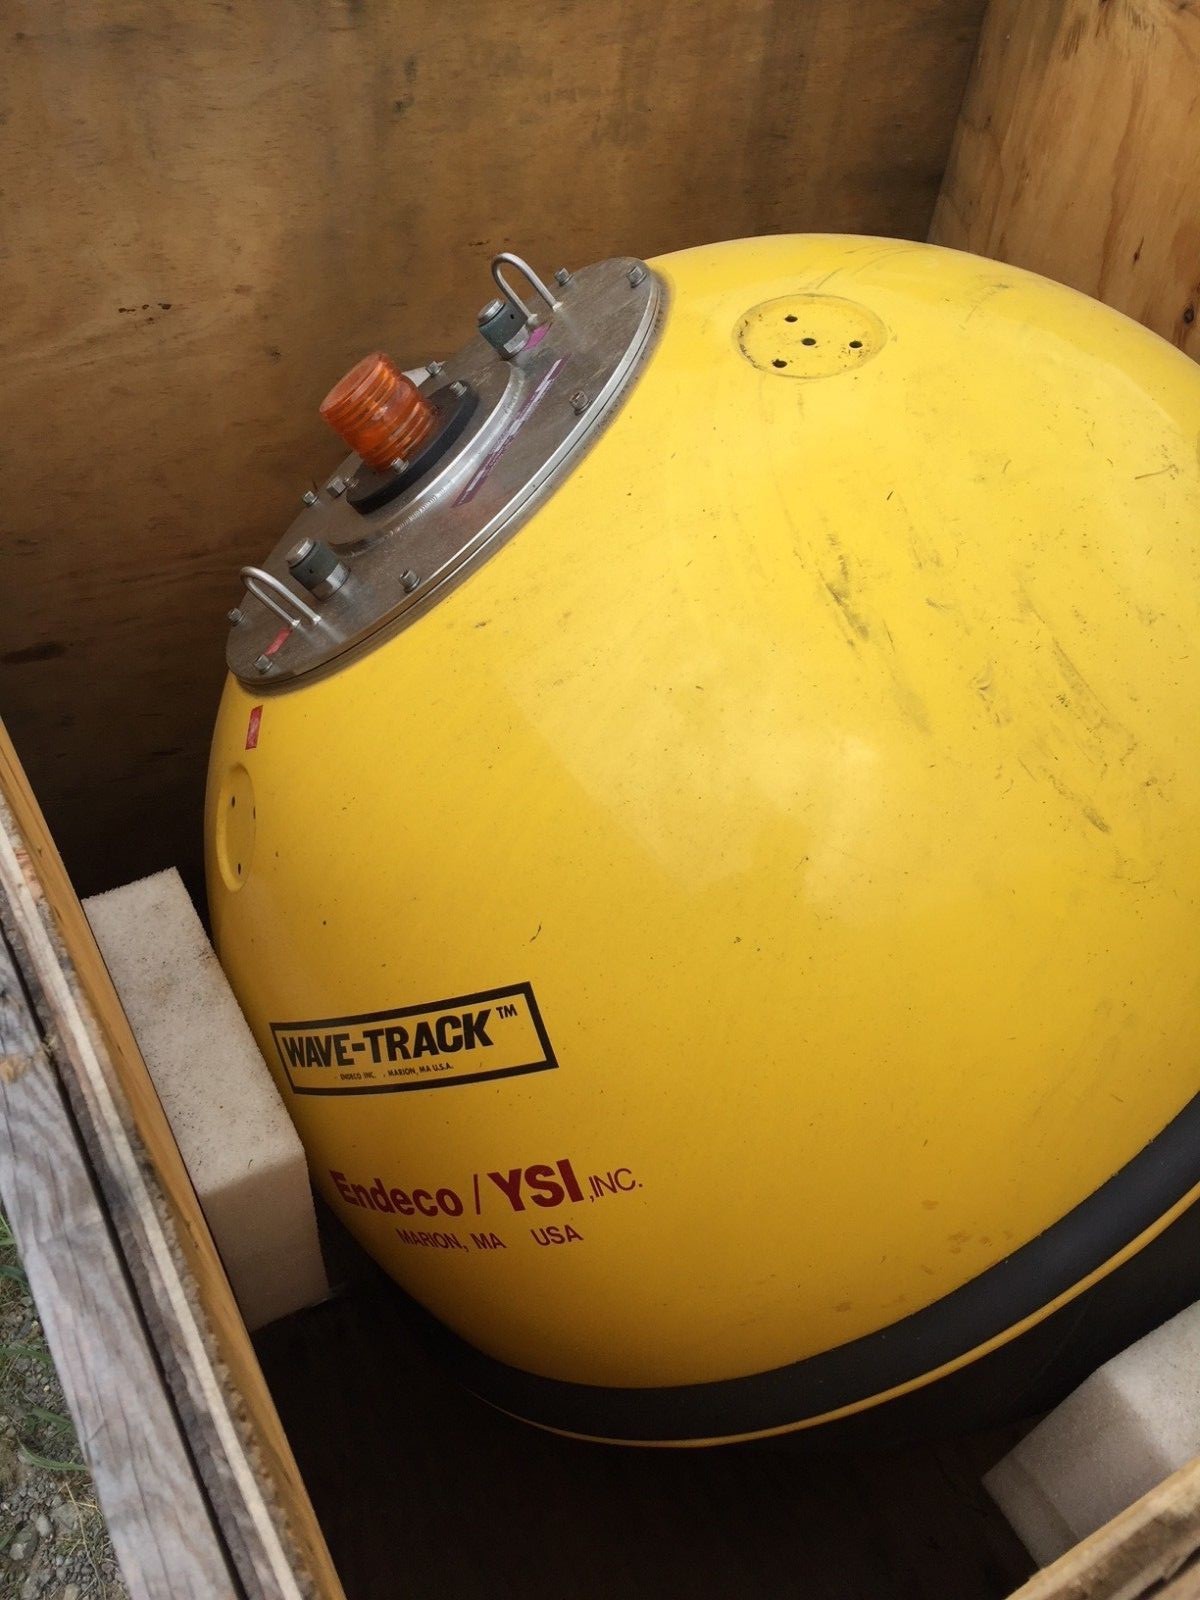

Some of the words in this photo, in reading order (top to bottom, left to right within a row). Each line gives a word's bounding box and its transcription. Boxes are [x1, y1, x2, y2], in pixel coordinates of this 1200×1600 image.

[281, 1009, 494, 1068] WAVE-TRACK
[419, 1064, 431, 1073] MA
[329, 1169, 464, 1217] Endeco
[396, 1228, 470, 1252] MARION,
[470, 1232, 507, 1250] MA
[530, 1224, 584, 1247] USA
